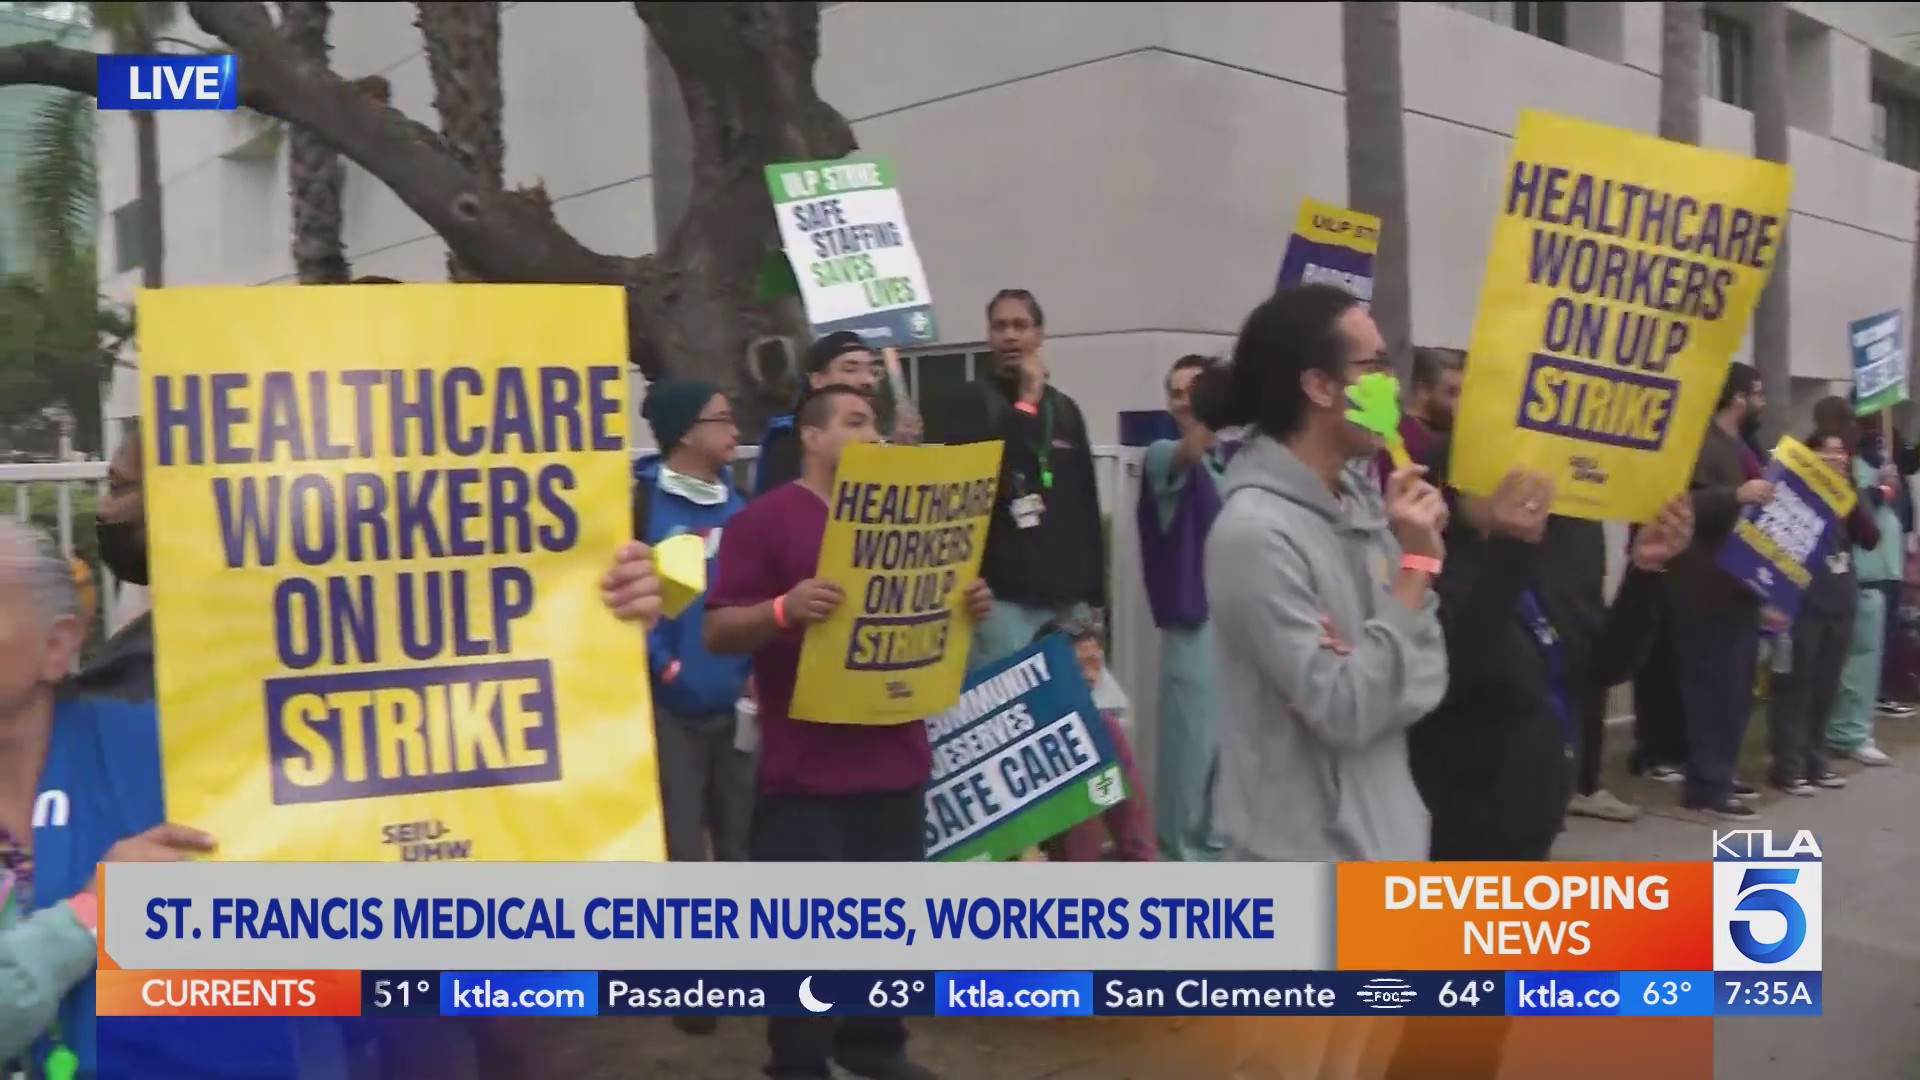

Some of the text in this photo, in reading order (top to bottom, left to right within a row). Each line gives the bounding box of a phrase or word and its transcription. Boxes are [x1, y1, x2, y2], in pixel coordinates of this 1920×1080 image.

[780, 170, 820, 198] ULP
[792, 199, 847, 232] SAFE
[1505, 160, 1778, 270] HEALTHCARE
[810, 253, 876, 288] SAVES
[811, 221, 902, 259] STAFFING
[1526, 228, 1737, 322] WORKERS
[863, 276, 916, 308] LIVES
[1542, 296, 1691, 375] ON ULP
[153, 365, 624, 466] HEALTHCARE
[1526, 364, 1669, 447] STRIKE
[212, 464, 579, 568] WORKERS
[834, 477, 998, 524] HEALTHCARE
[852, 523, 975, 570] WORKERS
[274, 566, 534, 670] ON ULP
[864, 570, 956, 615] ON ULP
[280, 677, 549, 789] STRIKE
[999, 721, 1089, 799] CARE
